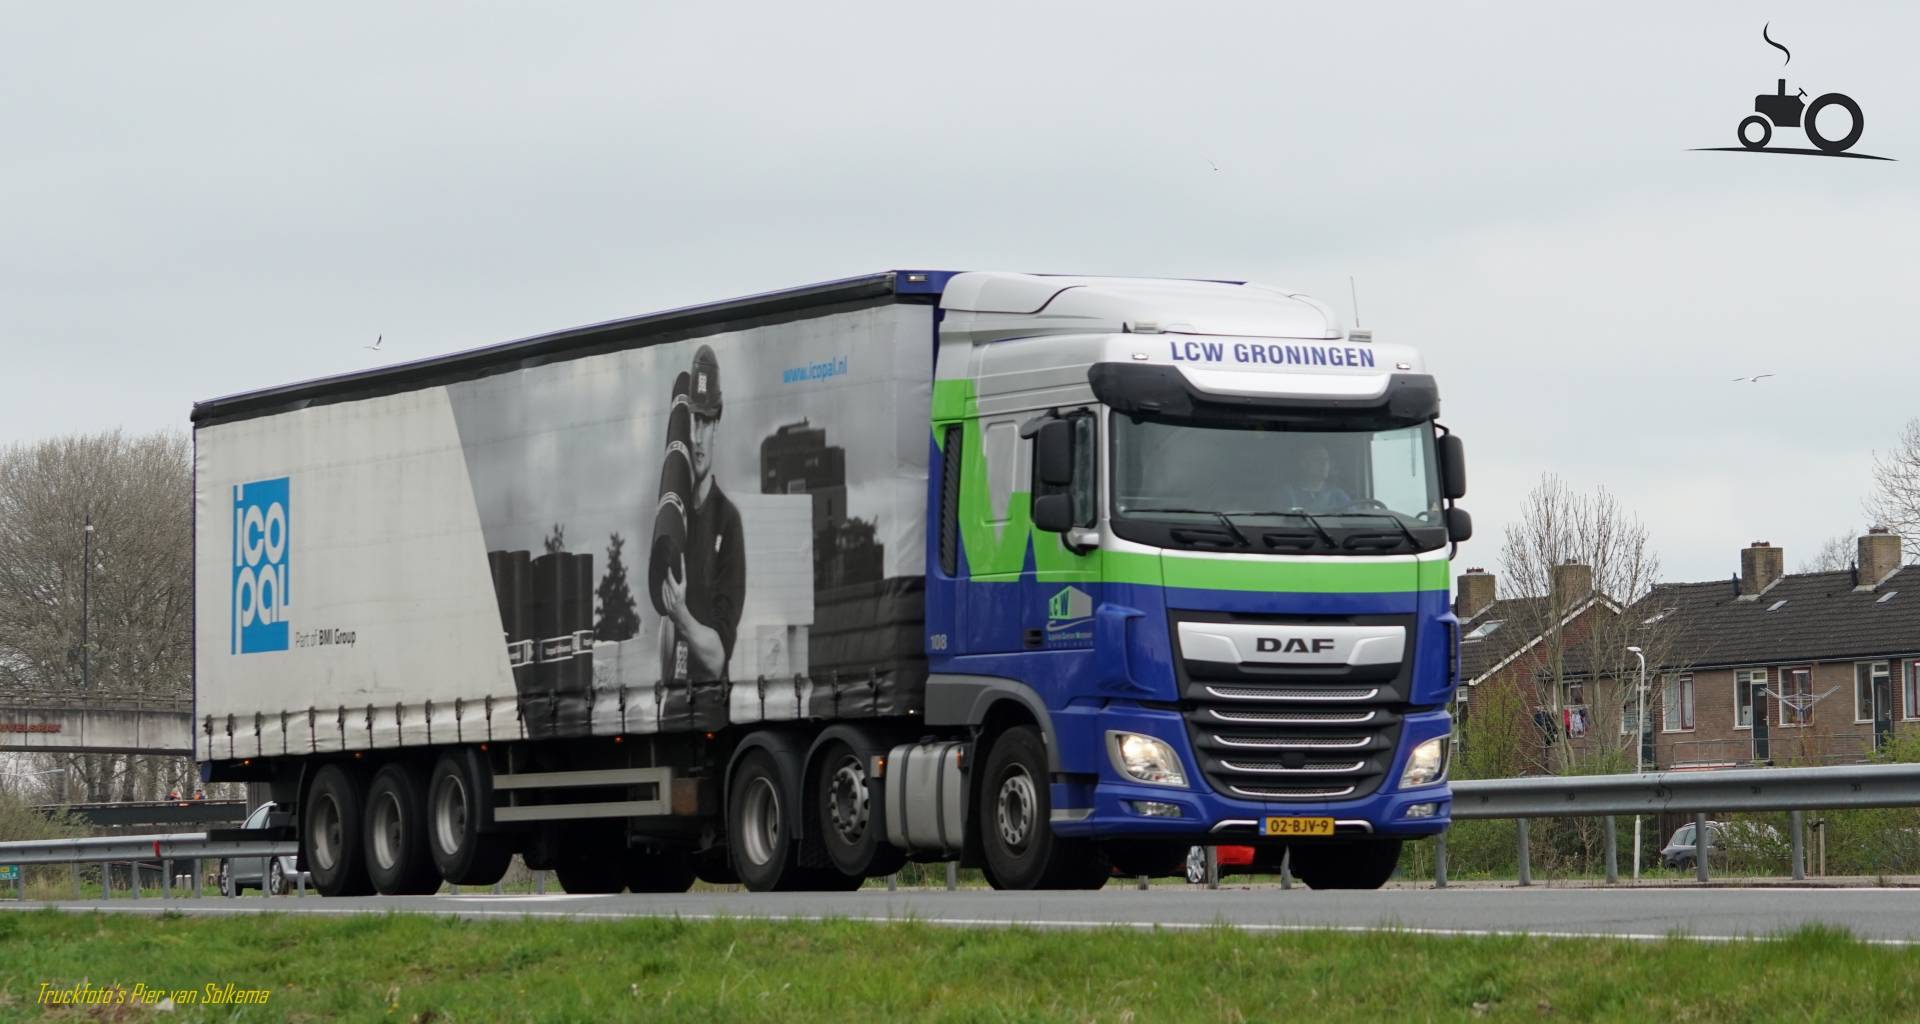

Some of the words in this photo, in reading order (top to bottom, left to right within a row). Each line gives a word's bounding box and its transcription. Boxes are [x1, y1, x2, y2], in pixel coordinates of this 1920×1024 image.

[1171, 341, 1224, 362] LCW
[1234, 343, 1375, 367] GRONINGEN
[783, 355, 846, 384] www.icopal.nl
[295, 631, 310, 648] Part
[311, 629, 318, 647] of
[319, 629, 333, 646] BMI
[335, 628, 356, 648] Group
[930, 634, 947, 650] 108
[1256, 637, 1335, 653] DAF
[1270, 819, 1329, 833] 02-BJV-9
